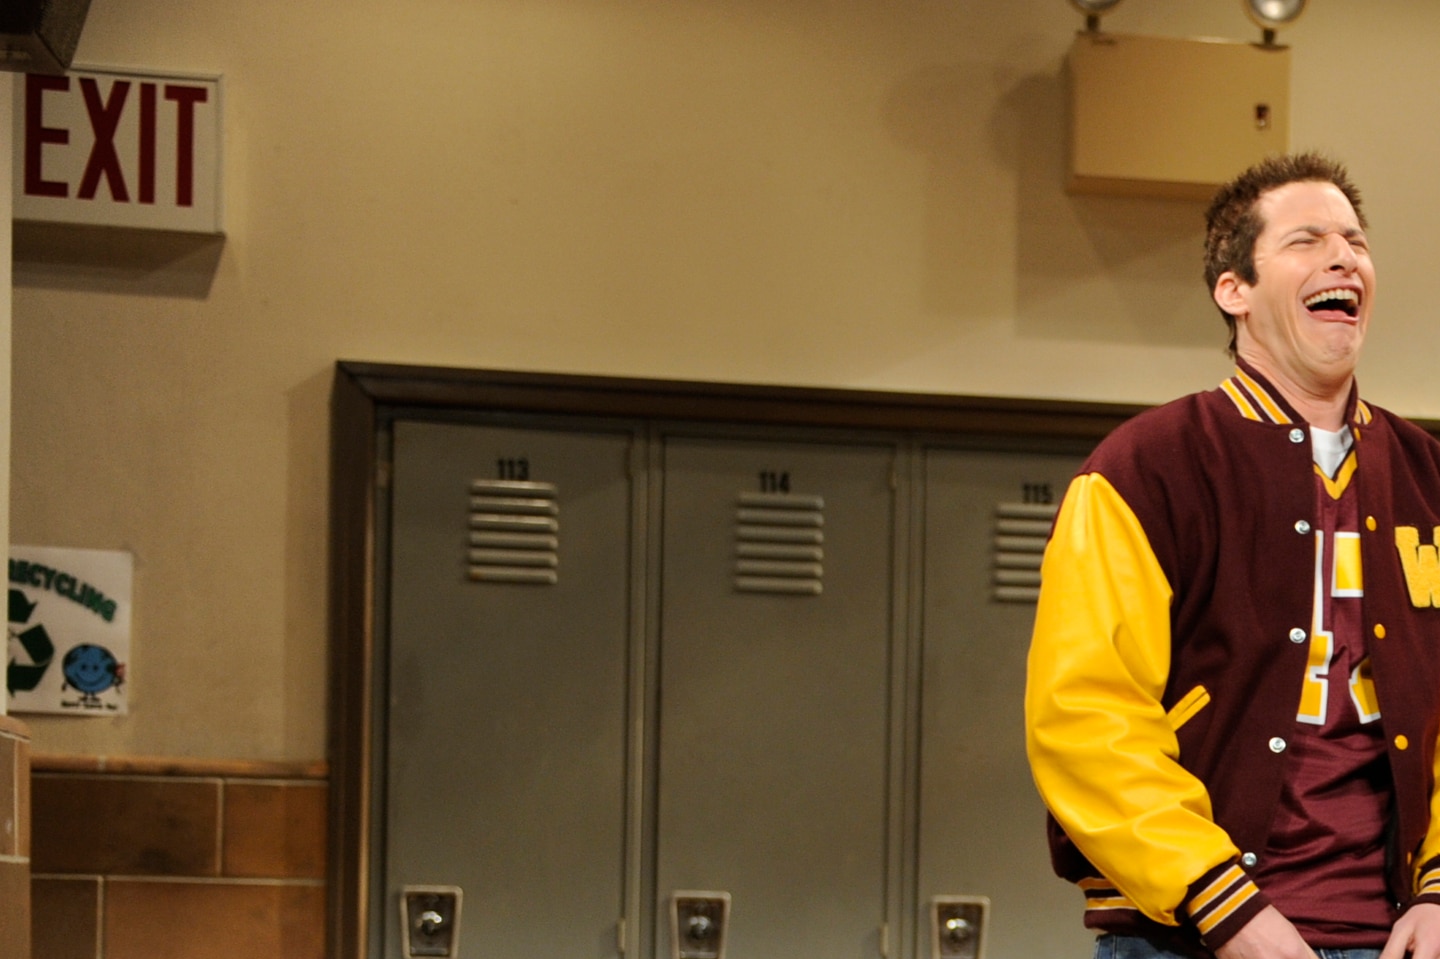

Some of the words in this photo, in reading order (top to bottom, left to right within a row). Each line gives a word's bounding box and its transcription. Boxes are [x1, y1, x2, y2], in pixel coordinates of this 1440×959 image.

[25, 73, 208, 207] EXIT
[497, 457, 529, 481] 113
[759, 470, 791, 495] 114
[1023, 483, 1053, 505] 115
